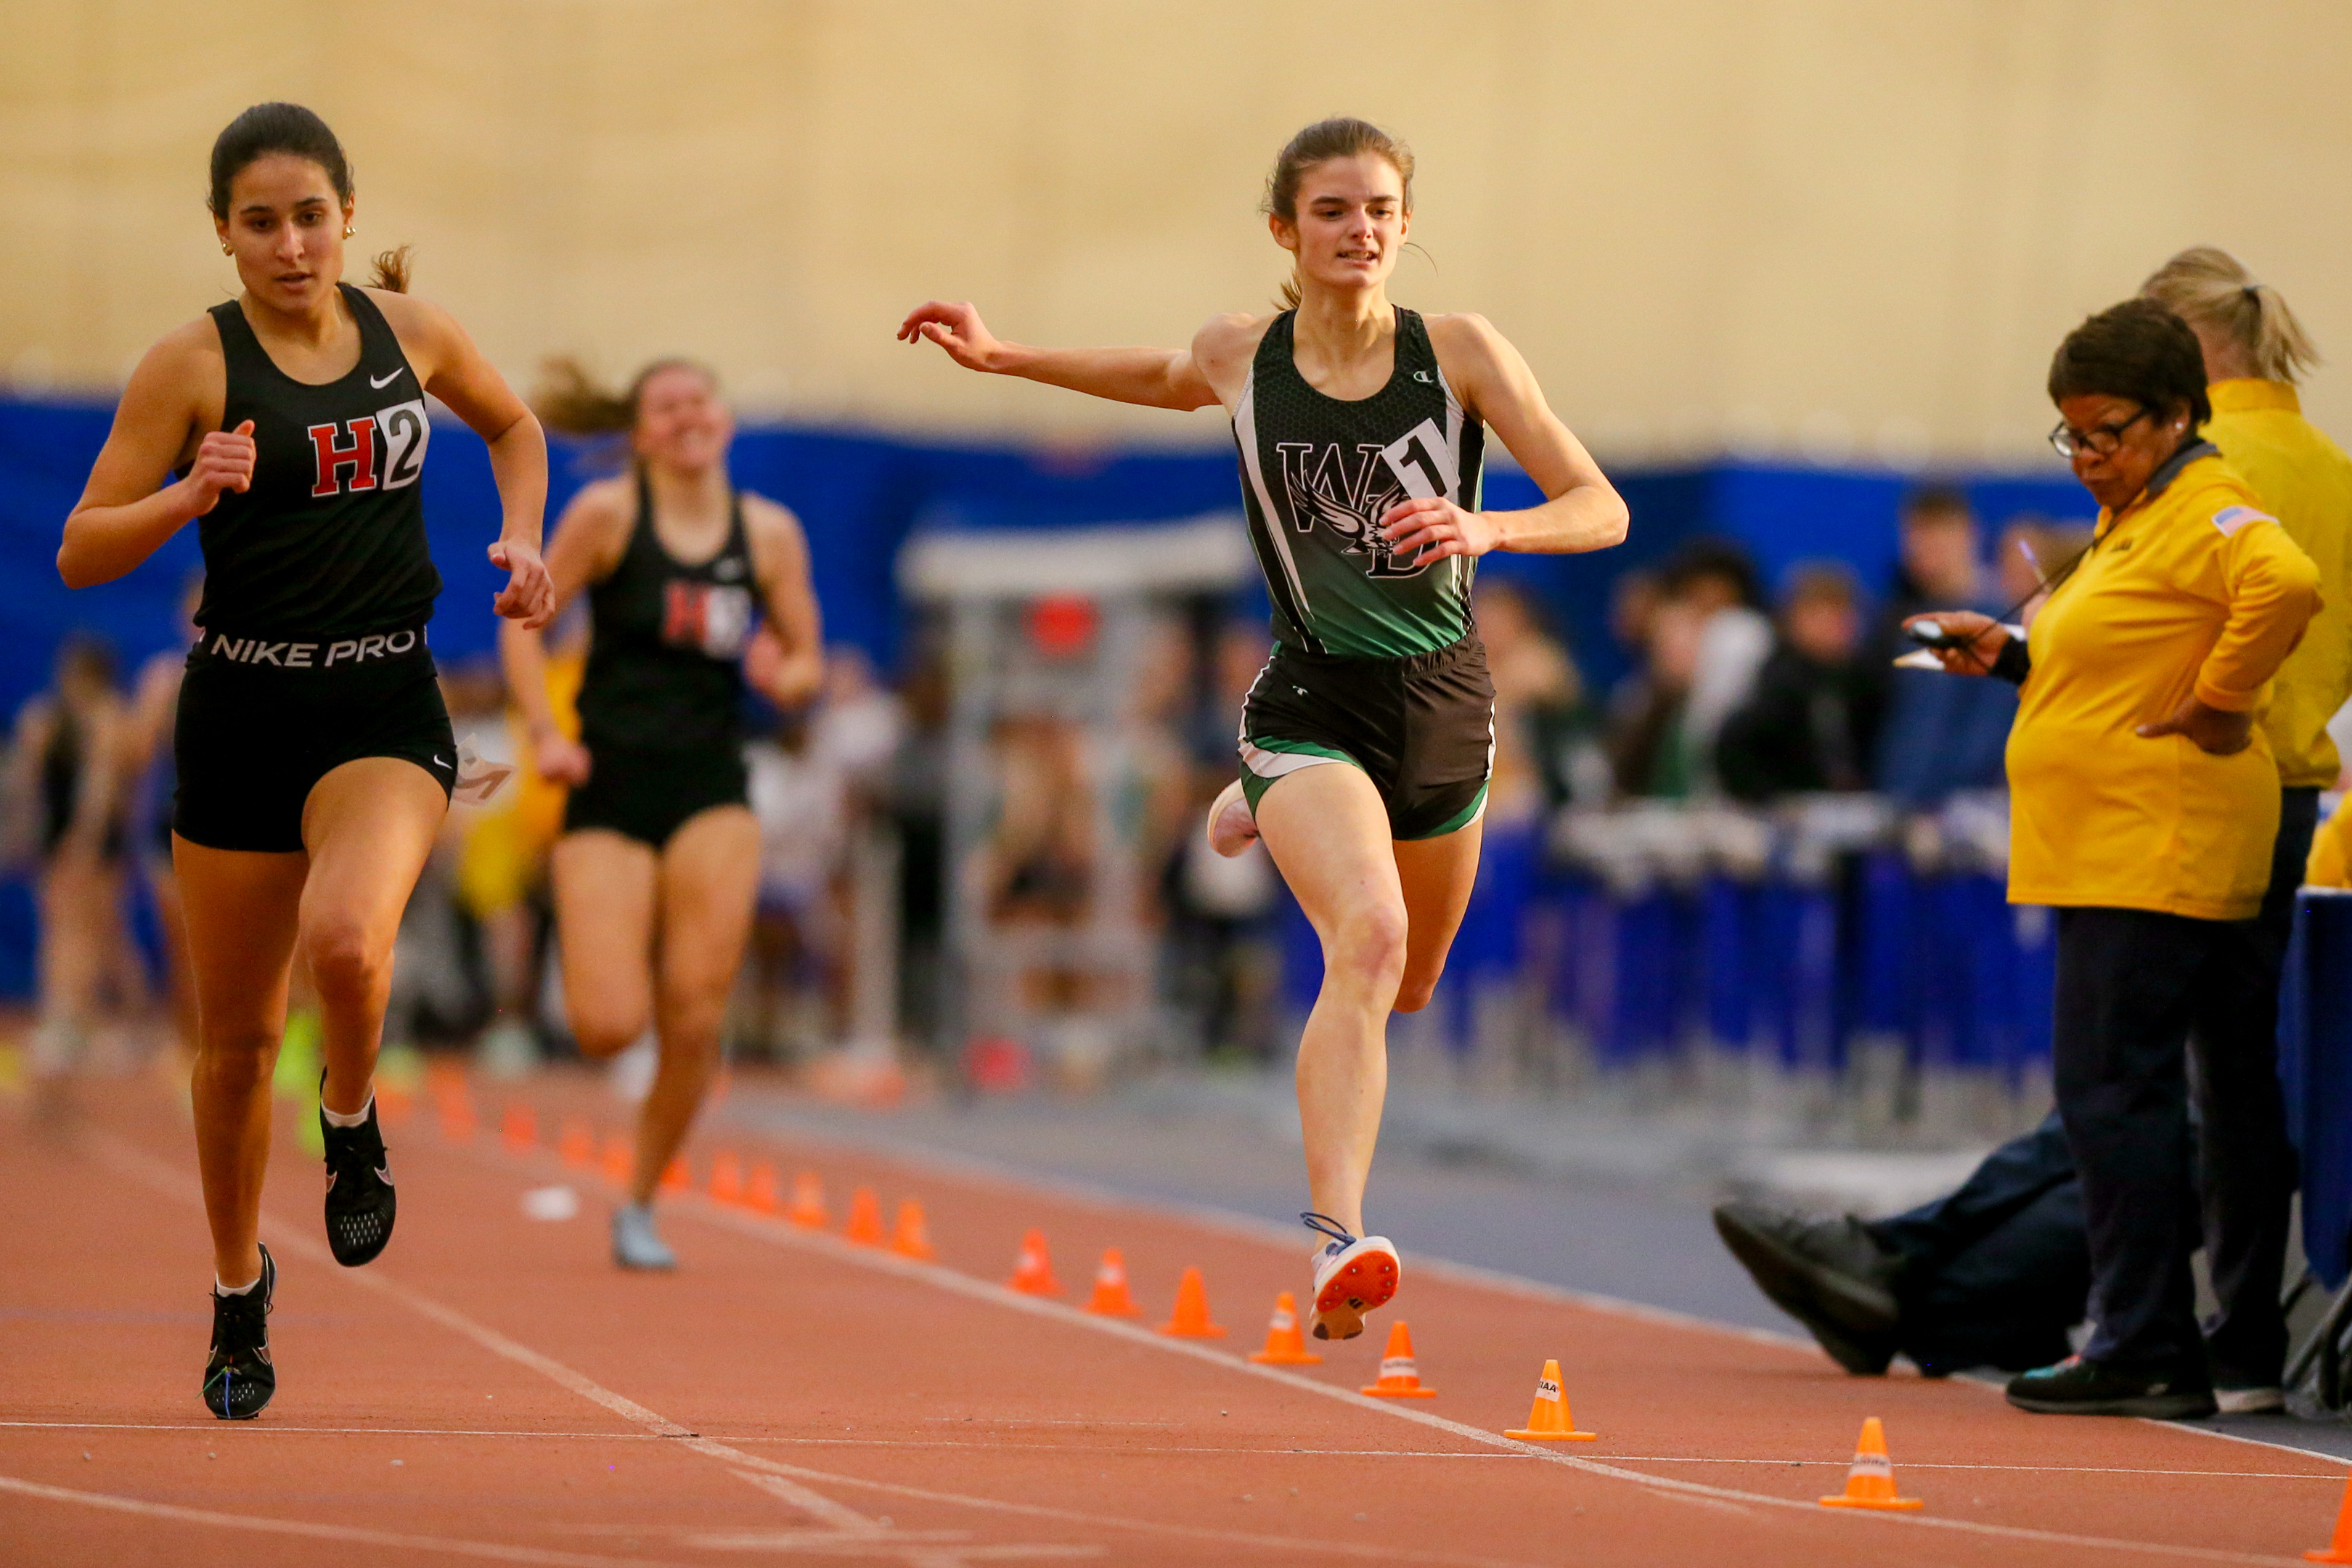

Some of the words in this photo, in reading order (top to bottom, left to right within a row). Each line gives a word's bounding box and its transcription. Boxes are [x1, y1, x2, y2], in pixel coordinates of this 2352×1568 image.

[307, 415, 377, 497] H
[389, 409, 422, 483] 2
[1399, 434, 1447, 497] 1
[211, 634, 319, 668] NIKE
[324, 629, 415, 667] PRO
